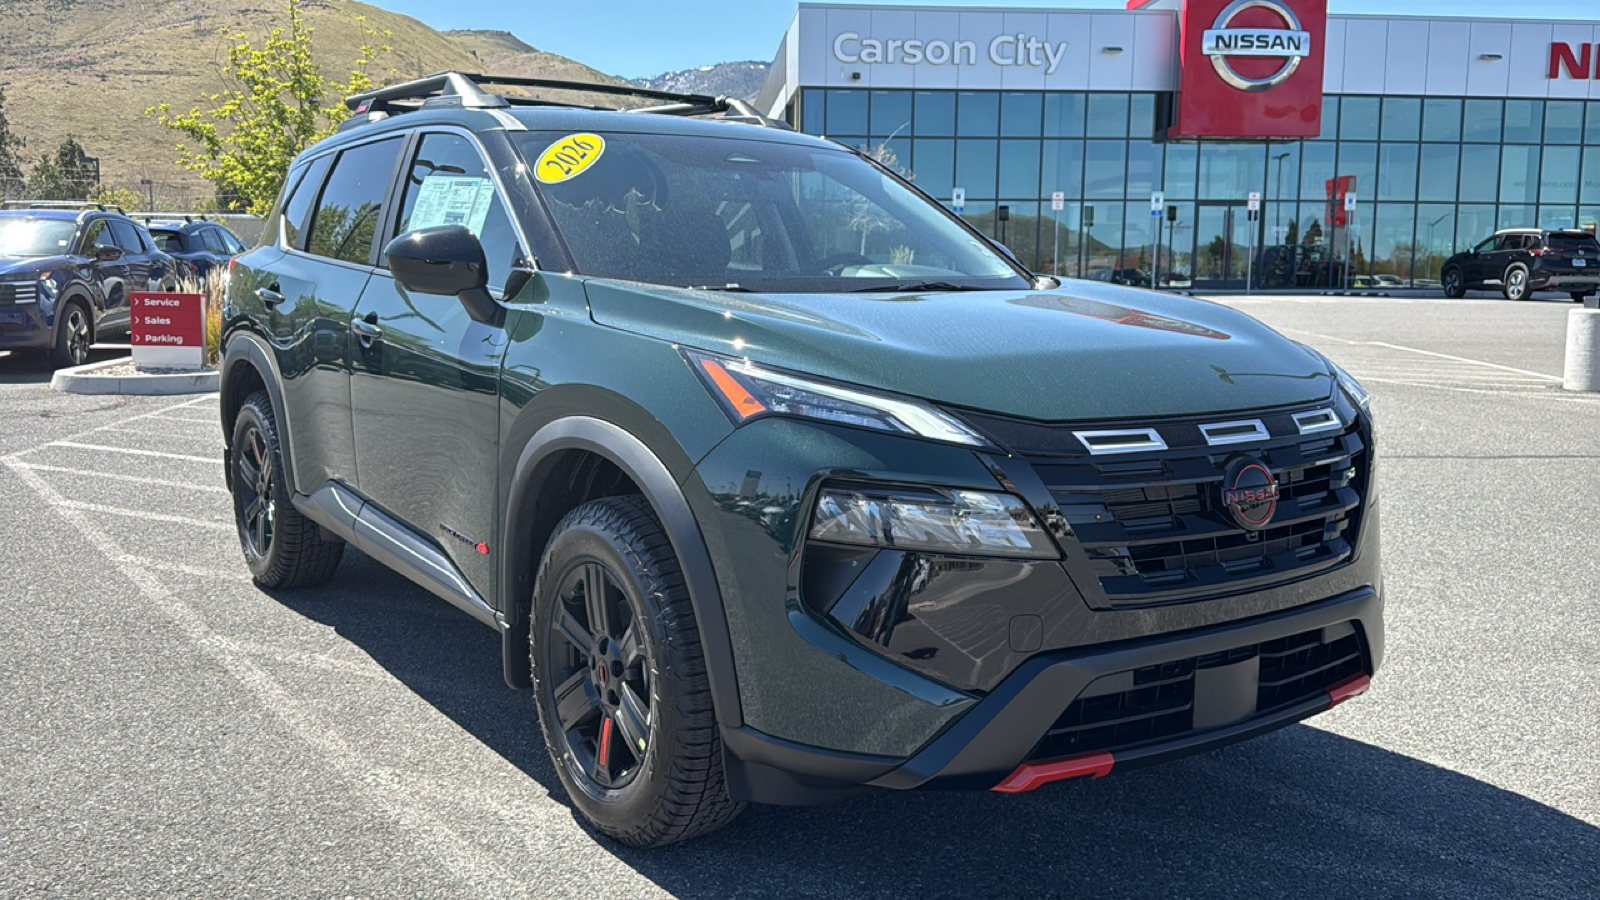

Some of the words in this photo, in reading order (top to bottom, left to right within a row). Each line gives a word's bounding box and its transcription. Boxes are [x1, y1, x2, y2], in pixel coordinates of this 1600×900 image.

[1215, 34, 1301, 51] NISSAN
[833, 32, 976, 65] Carson
[989, 33, 1067, 75] City
[546, 137, 595, 175] 2026
[144, 298, 180, 306] Service
[144, 316, 171, 325] Sales
[145, 334, 183, 345] Parking
[1226, 488, 1279, 503] NISSAN
